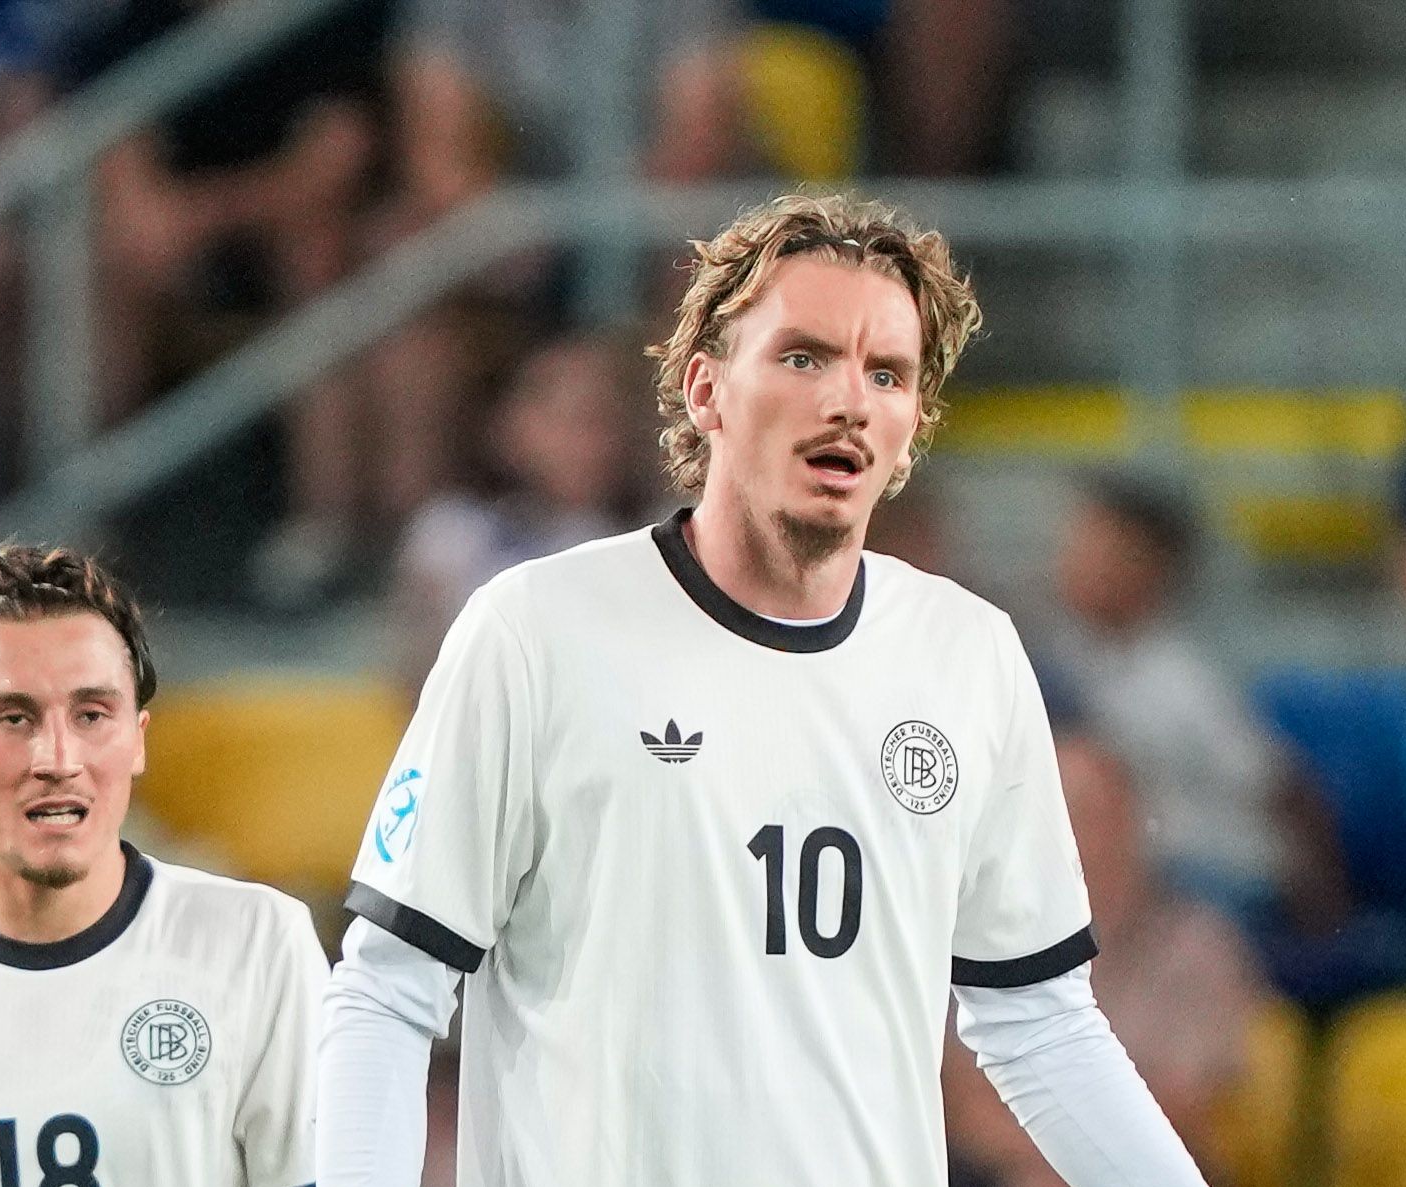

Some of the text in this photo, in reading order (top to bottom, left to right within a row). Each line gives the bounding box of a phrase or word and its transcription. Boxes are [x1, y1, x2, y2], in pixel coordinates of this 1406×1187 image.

[884, 727, 906, 797] DEUTSCHER
[909, 798, 926, 810] 125
[747, 823, 863, 959] 10
